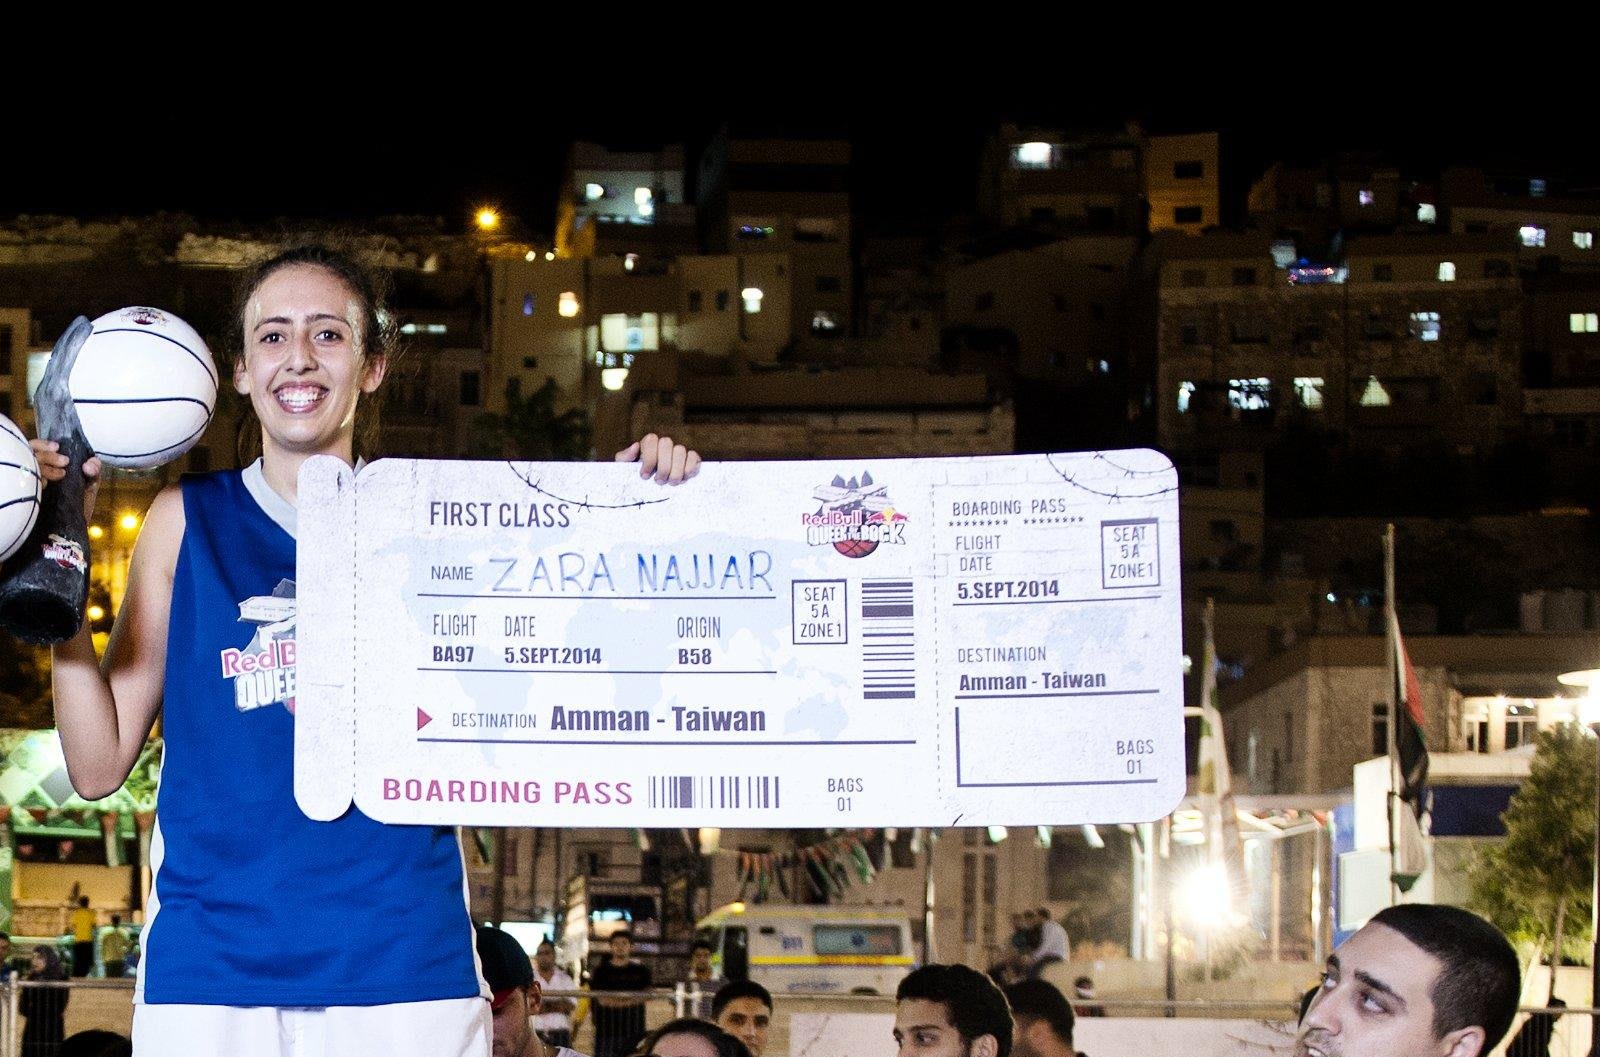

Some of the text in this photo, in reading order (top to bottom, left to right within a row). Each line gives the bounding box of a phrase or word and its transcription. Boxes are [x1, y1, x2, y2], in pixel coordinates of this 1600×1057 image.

[431, 501, 570, 528] FIRST CLASS
[953, 498, 1065, 516] BOARDING PASS
[956, 535, 1001, 550] FLIGHT
[1113, 526, 1147, 542] SEAT
[432, 566, 473, 580] NAME
[488, 550, 774, 593] ZARA NAJJAR
[960, 557, 992, 571] DATE
[804, 587, 836, 601] SEAT
[958, 580, 1059, 599] 5.SEPT.2014
[434, 614, 535, 637] FLIGHT DATE
[678, 617, 720, 638] ORIGIN
[221, 640, 277, 677] Red
[433, 646, 601, 664] BA97 5.SEPT.2014
[679, 649, 711, 664] B58
[958, 646, 1046, 662] DESTINATION
[234, 668, 296, 712] QUEE
[960, 675, 1026, 690] Amman
[1042, 672, 1105, 689] Taiwan
[453, 713, 536, 728] DESTINATION
[551, 706, 649, 731] Amman
[672, 706, 765, 731] Taiwan
[1117, 740, 1153, 755] BAGS
[1127, 759, 1141, 774] 01
[384, 778, 632, 804] BOARDING PASS
[828, 778, 863, 792] BAGS
[838, 797, 851, 811] 01
